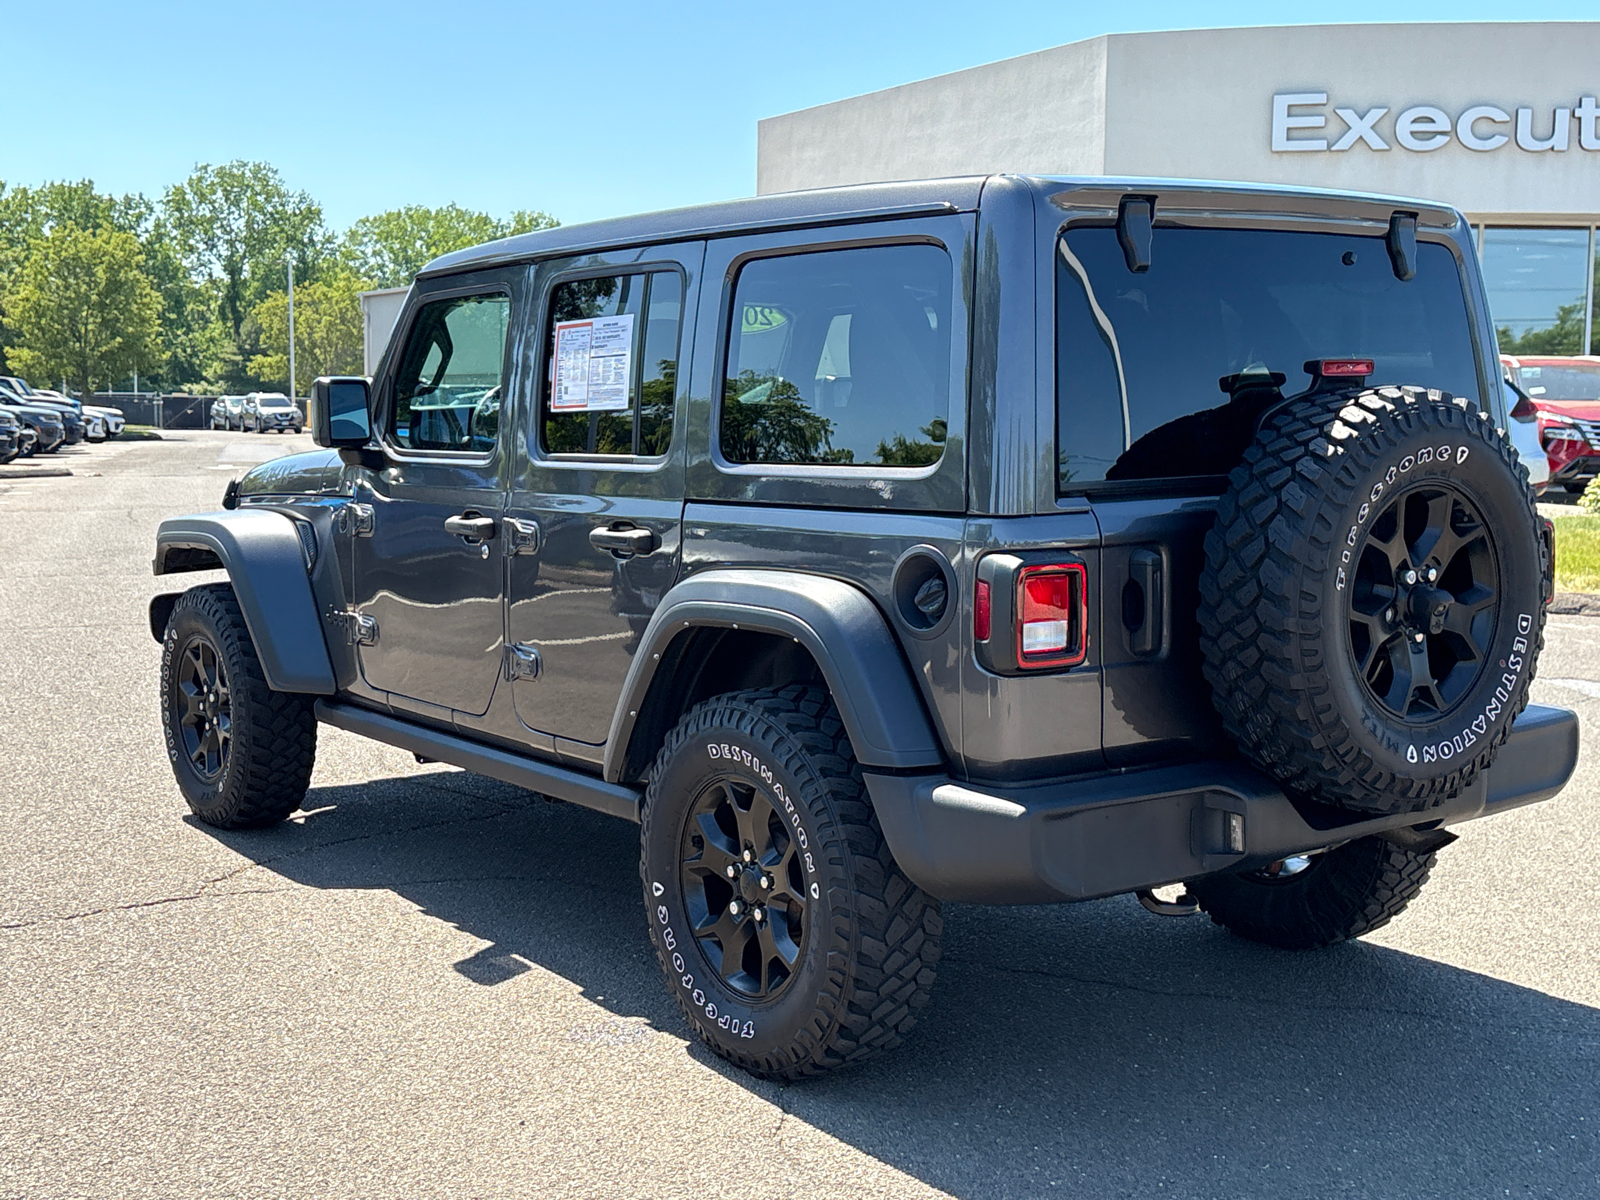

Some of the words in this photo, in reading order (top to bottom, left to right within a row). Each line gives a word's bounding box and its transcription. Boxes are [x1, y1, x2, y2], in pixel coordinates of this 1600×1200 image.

[1335, 444, 1451, 591] Firestone
[1422, 613, 1532, 764] DESTINATION
[707, 743, 817, 873] DESTINATION
